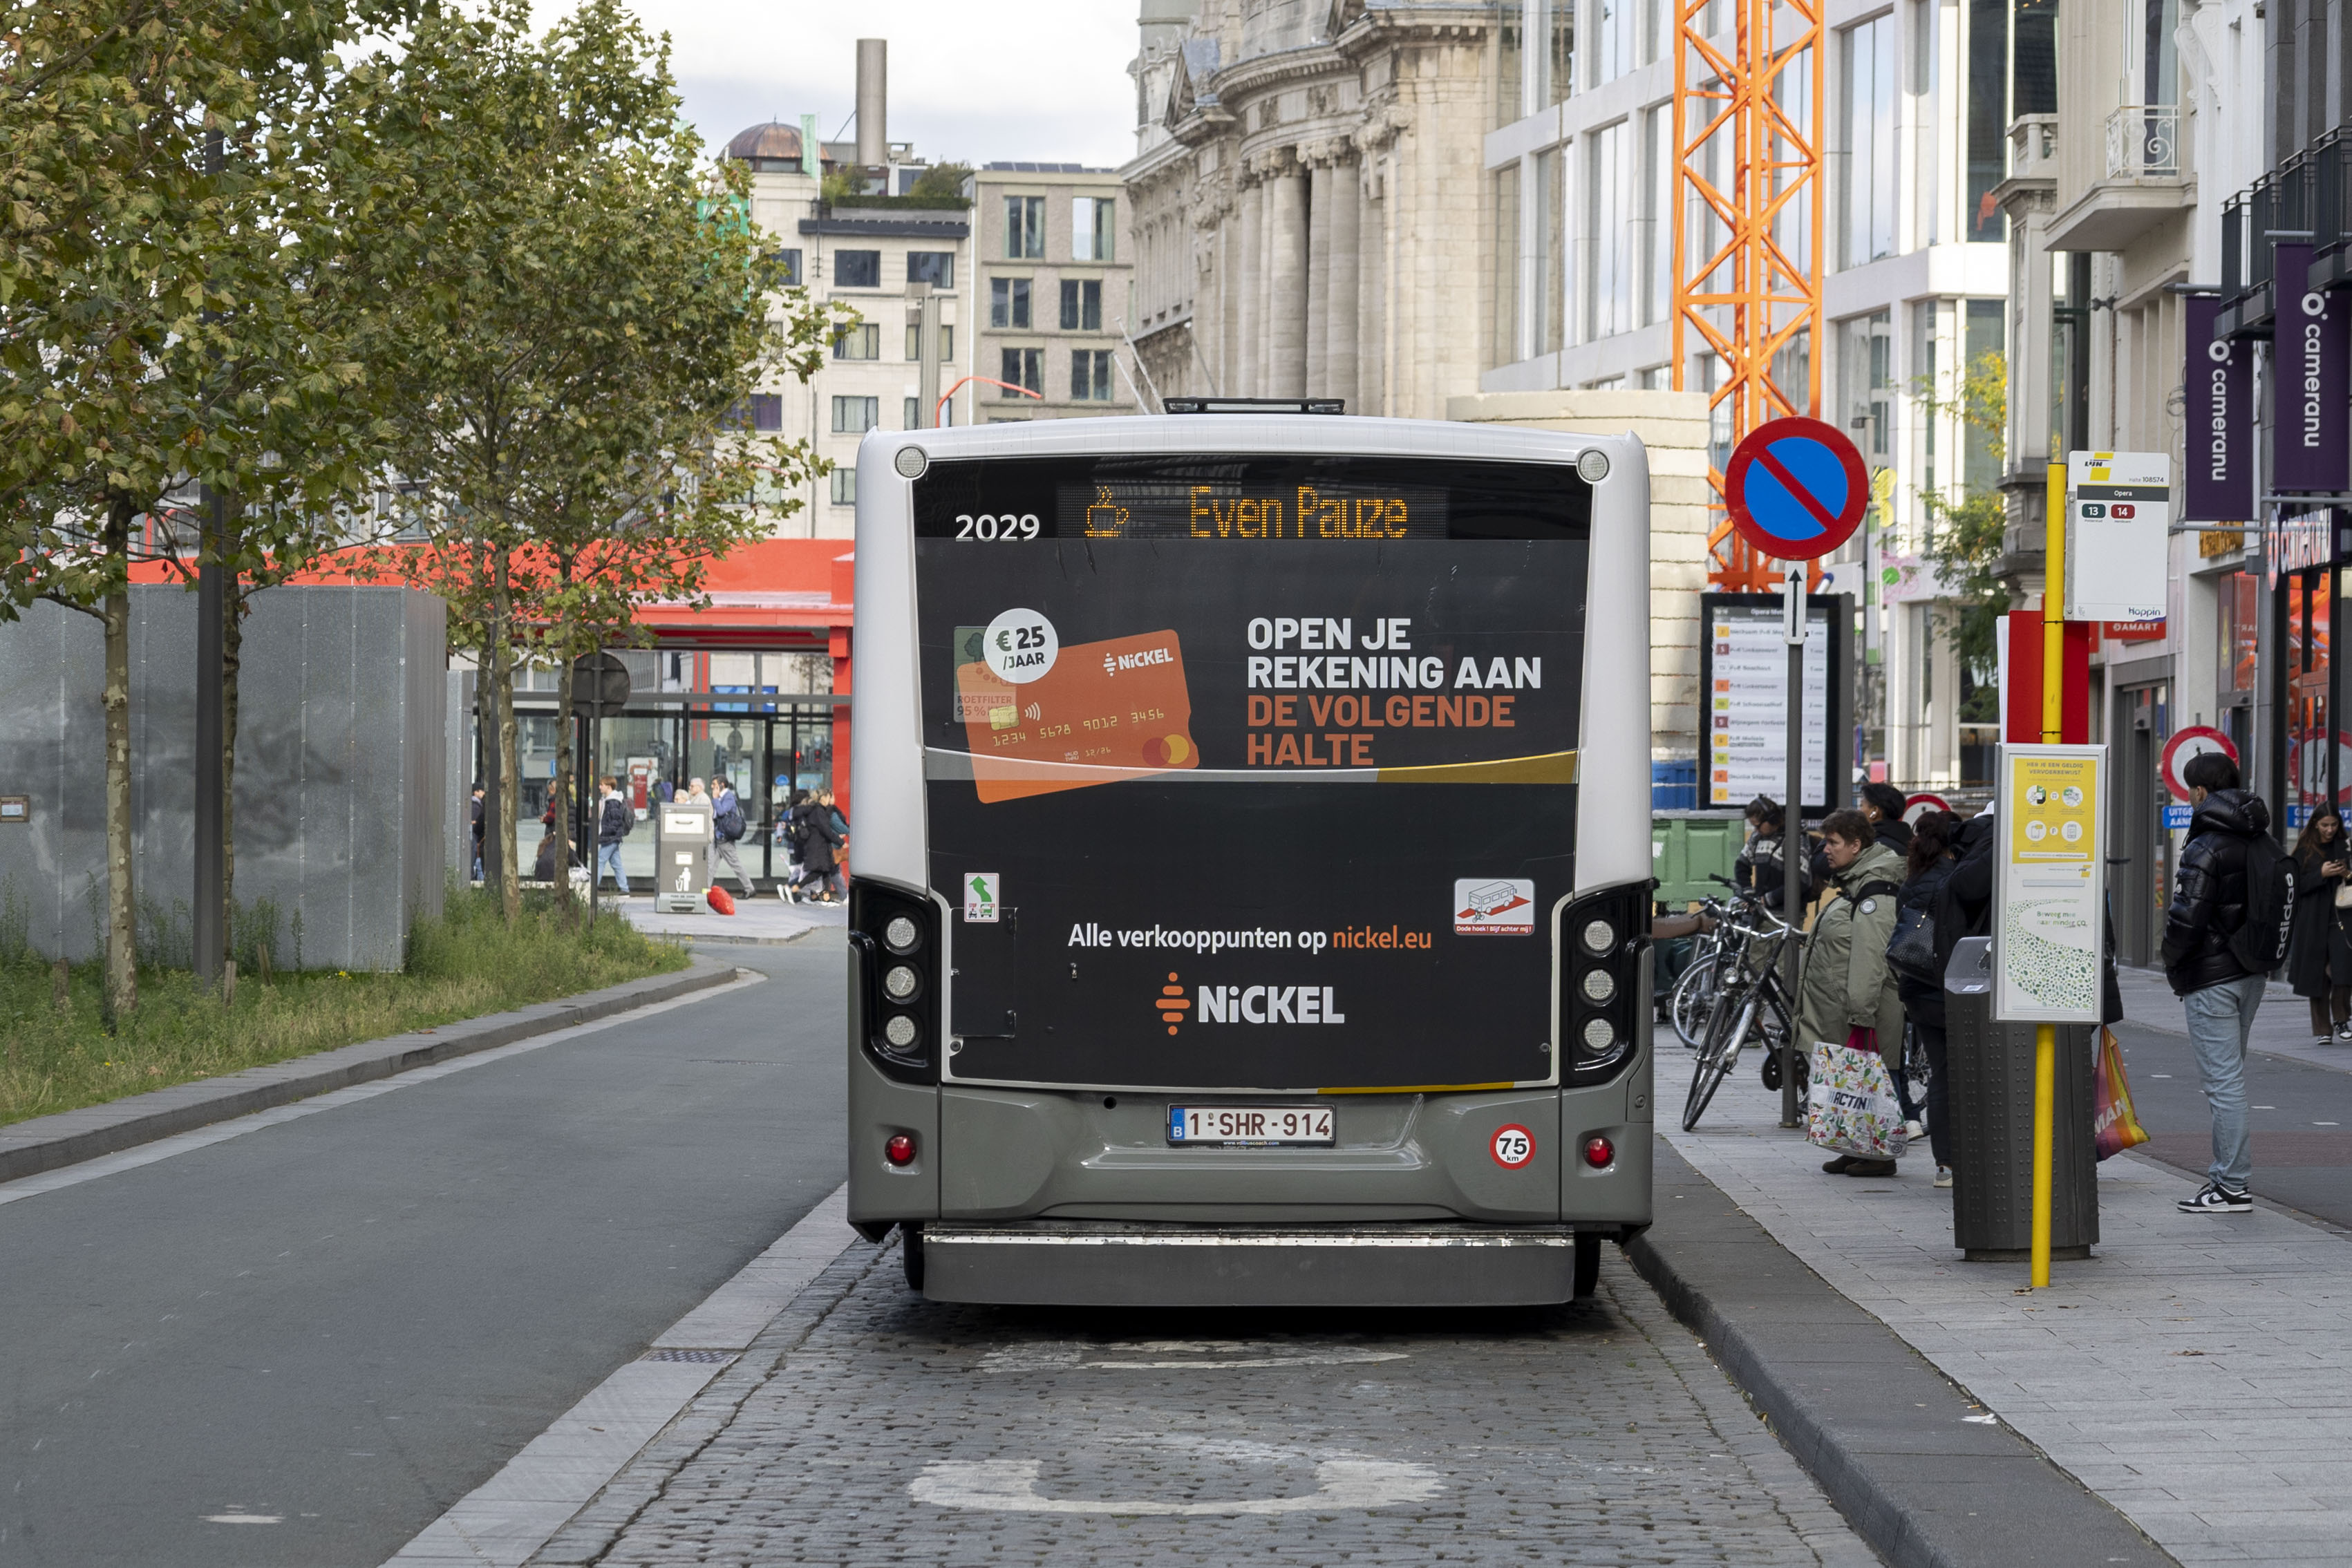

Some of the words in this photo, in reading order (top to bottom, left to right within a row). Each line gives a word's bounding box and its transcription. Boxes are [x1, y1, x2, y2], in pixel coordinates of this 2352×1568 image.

[2304, 324, 2321, 447] cameranu
[2212, 369, 2226, 481] cameranu
[1190, 486, 1281, 538] Even
[1298, 486, 1408, 538] Pauze
[2088, 507, 2098, 516] 13
[2118, 507, 2128, 516] 14
[955, 514, 1040, 541] 2029
[2128, 607, 2161, 617] Hoppin
[1247, 618, 1351, 650] OPEN
[1361, 618, 1411, 650] JE
[1003, 652, 1046, 670] /JAAR
[1247, 657, 1445, 689] REKENING
[1454, 657, 1542, 689] AAN
[957, 695, 1012, 703] ROETFILTER
[1247, 695, 1297, 727] DE
[1308, 695, 1516, 727] VOLGENDE
[992, 732, 1026, 747] 1234
[1039, 724, 1071, 739] 5678
[1083, 715, 1117, 730] 9012
[1131, 708, 1164, 724] 3456
[1247, 733, 1374, 766] HALTE
[1068, 923, 1112, 947] Alle
[1117, 924, 1291, 954] verkooppunten
[1297, 932, 1326, 954] op
[1333, 925, 1431, 949] nickel.eu
[1833, 1091, 1867, 1110] ACTIN
[1174, 1126, 1183, 1137] B
[1499, 1137, 1527, 1155] 75
